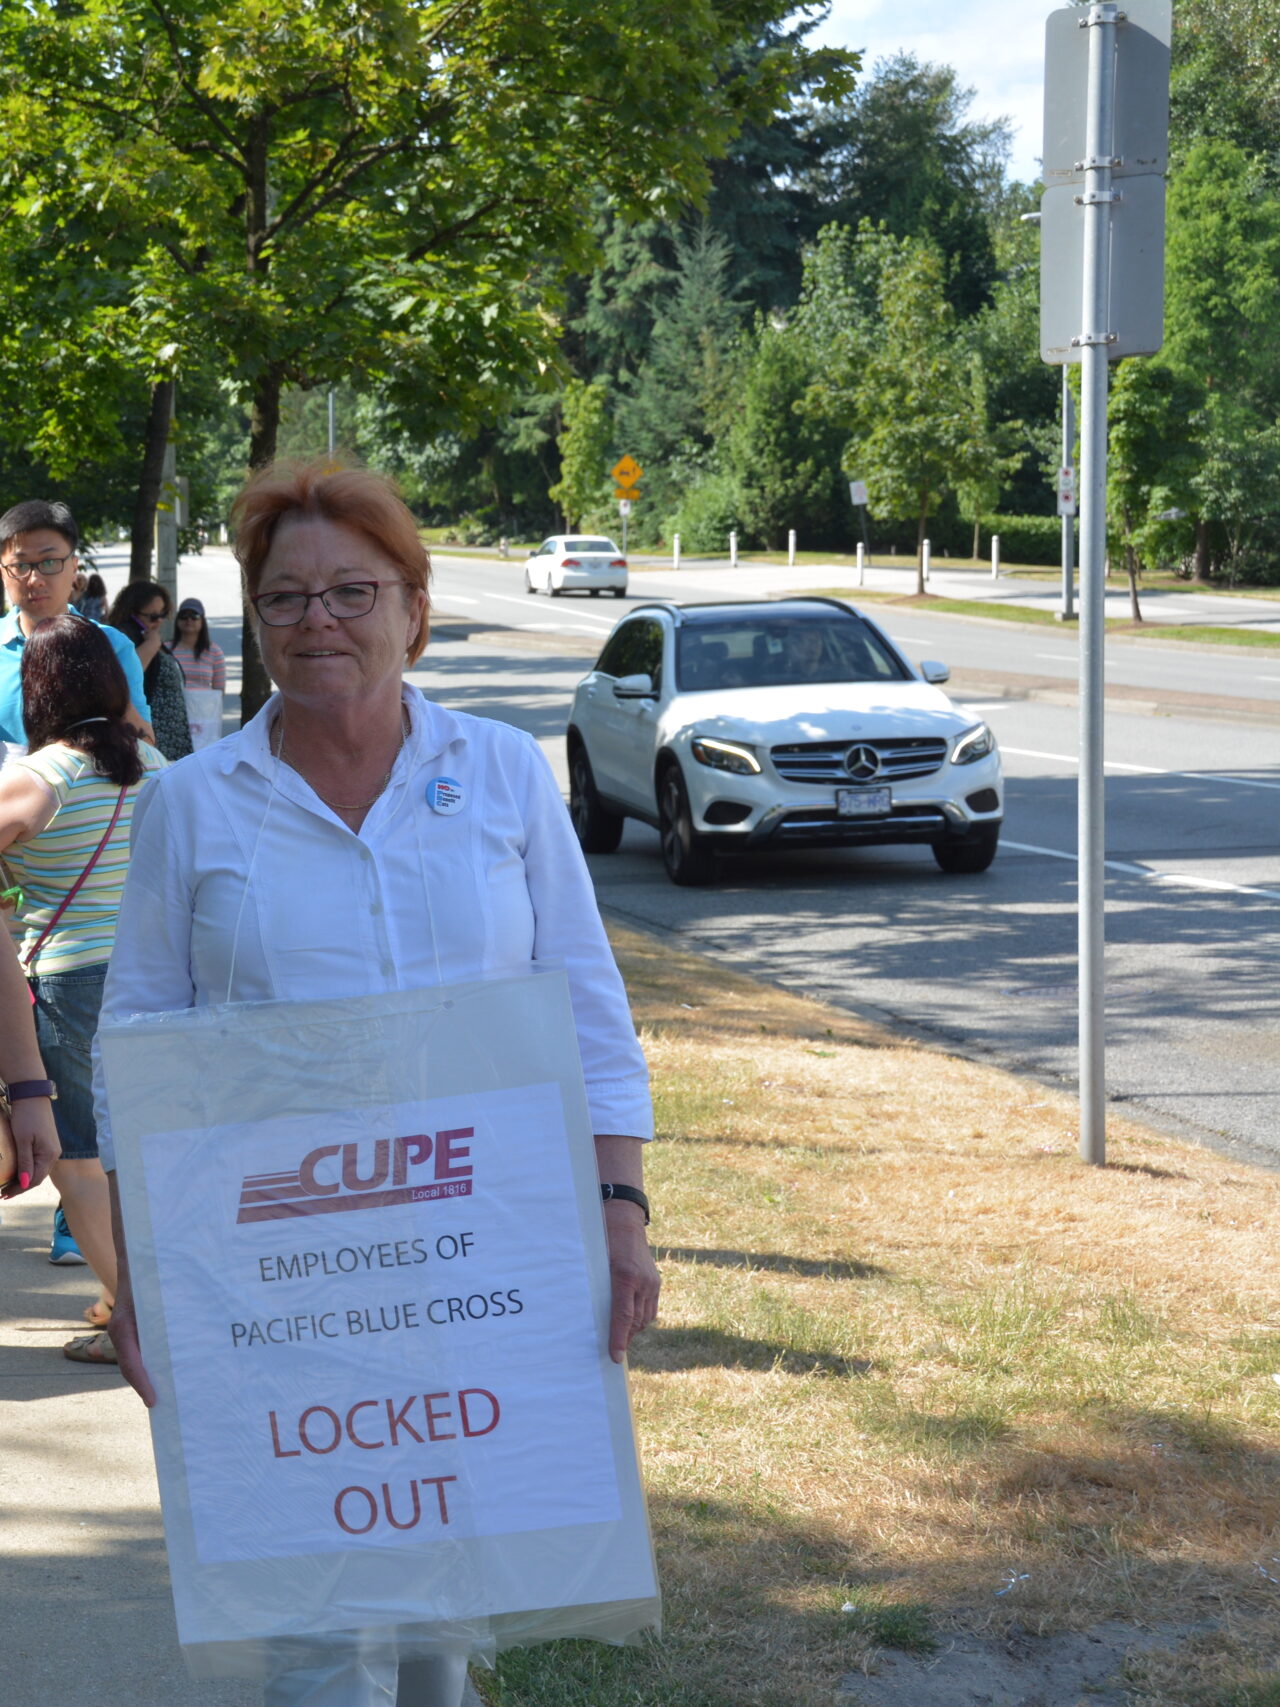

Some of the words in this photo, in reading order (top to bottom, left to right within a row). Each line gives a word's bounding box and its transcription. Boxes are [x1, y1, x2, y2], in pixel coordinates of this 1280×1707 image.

[298, 1126, 475, 1195] CUPE
[412, 1186, 441, 1200] Local
[443, 1183, 467, 1196] 1816
[258, 1238, 428, 1282] EMPLOYEES
[436, 1232, 475, 1261] OF
[231, 1311, 340, 1348] PACIFIC
[347, 1302, 419, 1336] BLUE
[426, 1288, 524, 1324] CROSS
[268, 1387, 501, 1458] LOCKED
[333, 1475, 457, 1535] OUT
